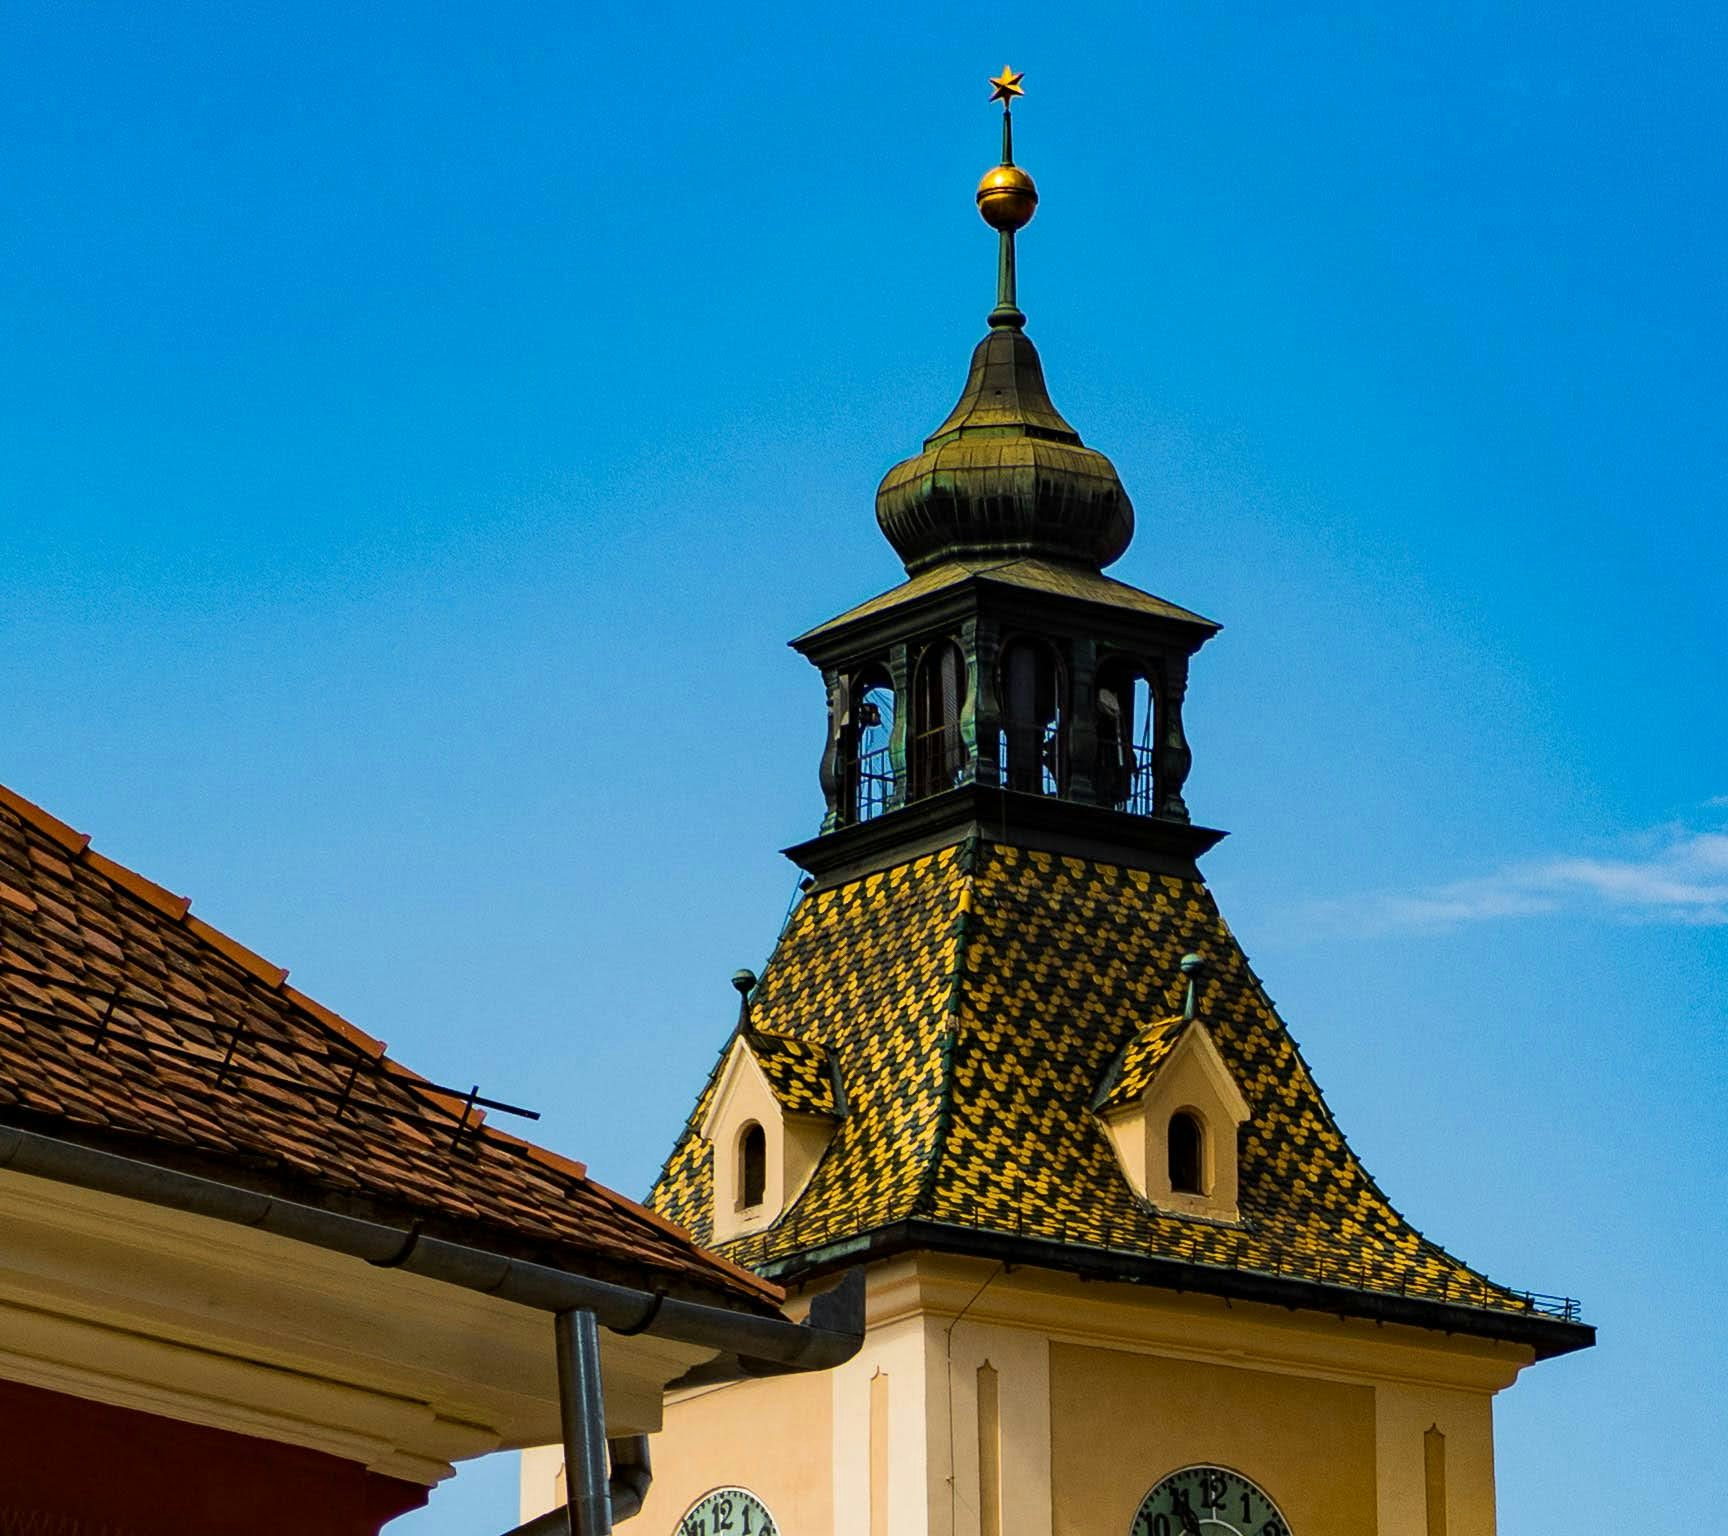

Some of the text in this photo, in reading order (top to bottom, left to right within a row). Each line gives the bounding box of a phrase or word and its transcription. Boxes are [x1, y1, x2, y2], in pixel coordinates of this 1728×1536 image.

[1199, 1477, 1228, 1511] 12
[1240, 1492, 1252, 1524] 1
[711, 1498, 733, 1534] 12
[741, 1503, 752, 1536] 1
